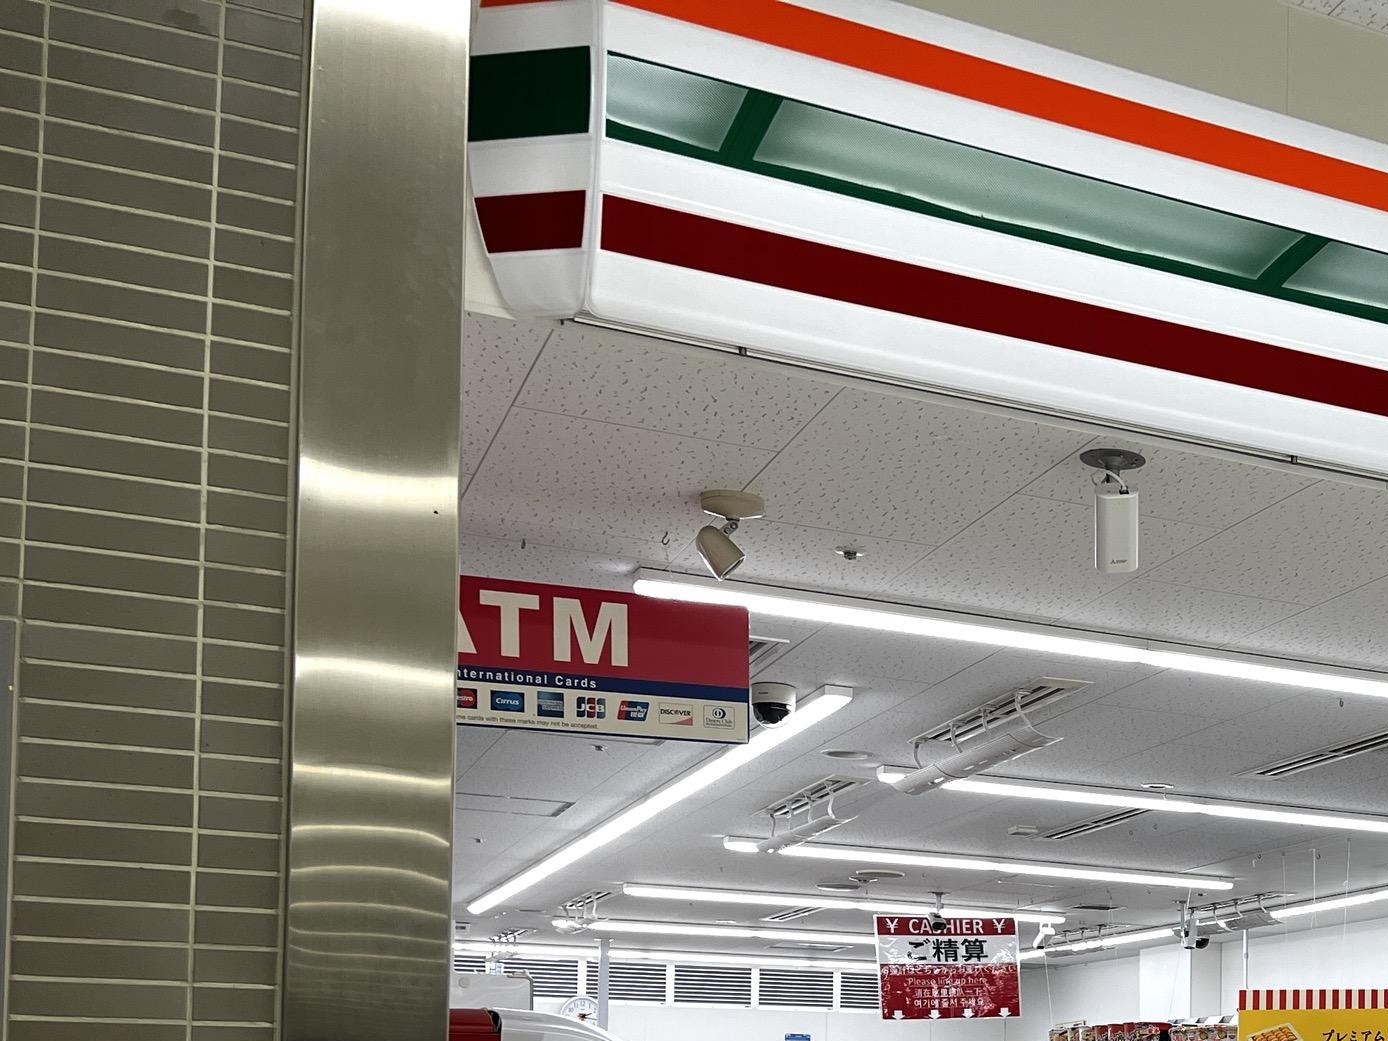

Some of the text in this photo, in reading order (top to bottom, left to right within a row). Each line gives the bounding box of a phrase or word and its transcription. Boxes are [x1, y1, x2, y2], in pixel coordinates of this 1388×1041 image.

[457, 669, 597, 688] nternational Cards
[660, 708, 691, 717] DISCOVER
[907, 938, 989, 962] ご精算
